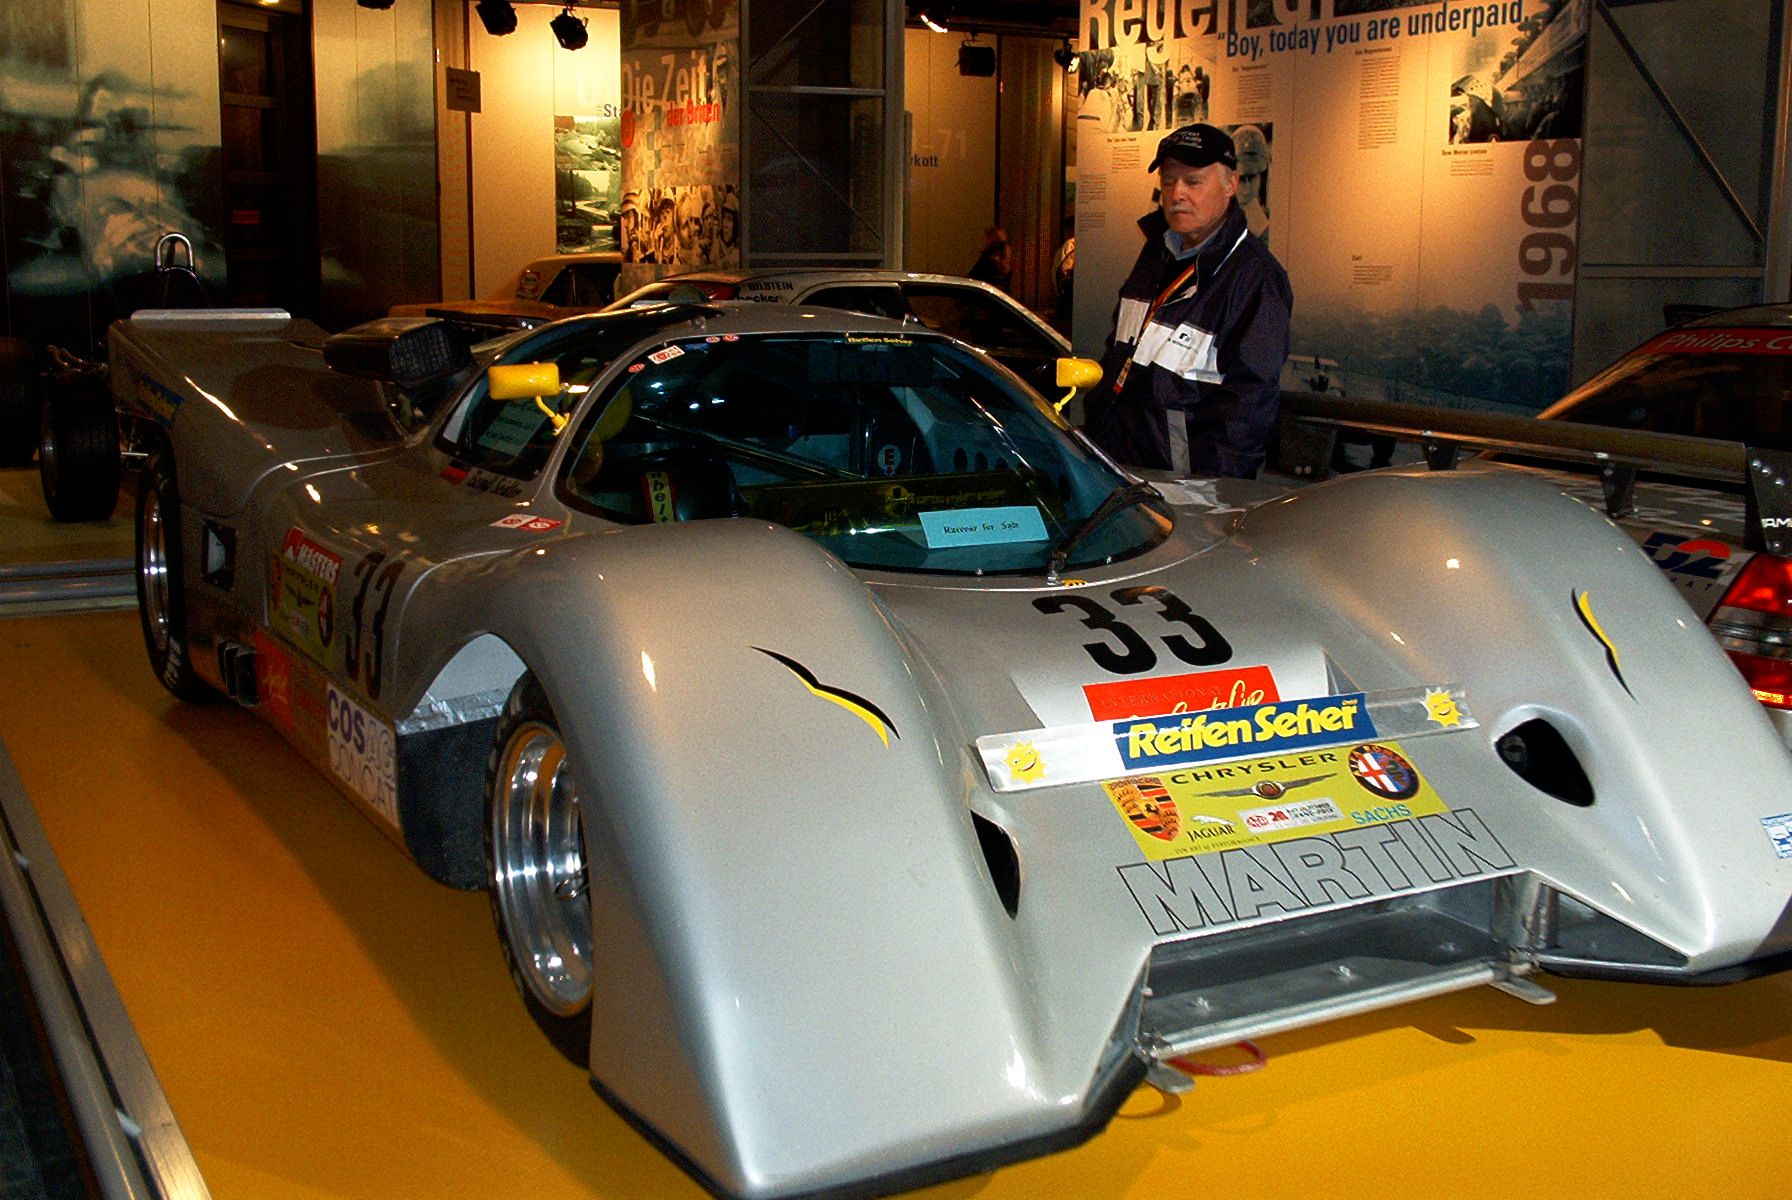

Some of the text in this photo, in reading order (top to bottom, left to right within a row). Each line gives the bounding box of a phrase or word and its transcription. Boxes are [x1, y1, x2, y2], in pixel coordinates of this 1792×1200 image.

[1269, 25, 1320, 55] today
[1325, 21, 1360, 53] you
[1367, 16, 1400, 40] are
[1517, 138, 1582, 312] 1968
[748, 280, 794, 291] BILSTEIN
[1658, 333, 1760, 351] Philips
[1031, 585, 1234, 675] 33
[327, 688, 365, 754] COS
[1129, 714, 1252, 759] Reifen
[1254, 702, 1358, 742] Seher
[1170, 752, 1339, 785] CHRYSLER
[1186, 824, 1236, 842] JAGUAR
[1351, 803, 1412, 825] SACHS
[1116, 807, 1519, 936] MARTIN
